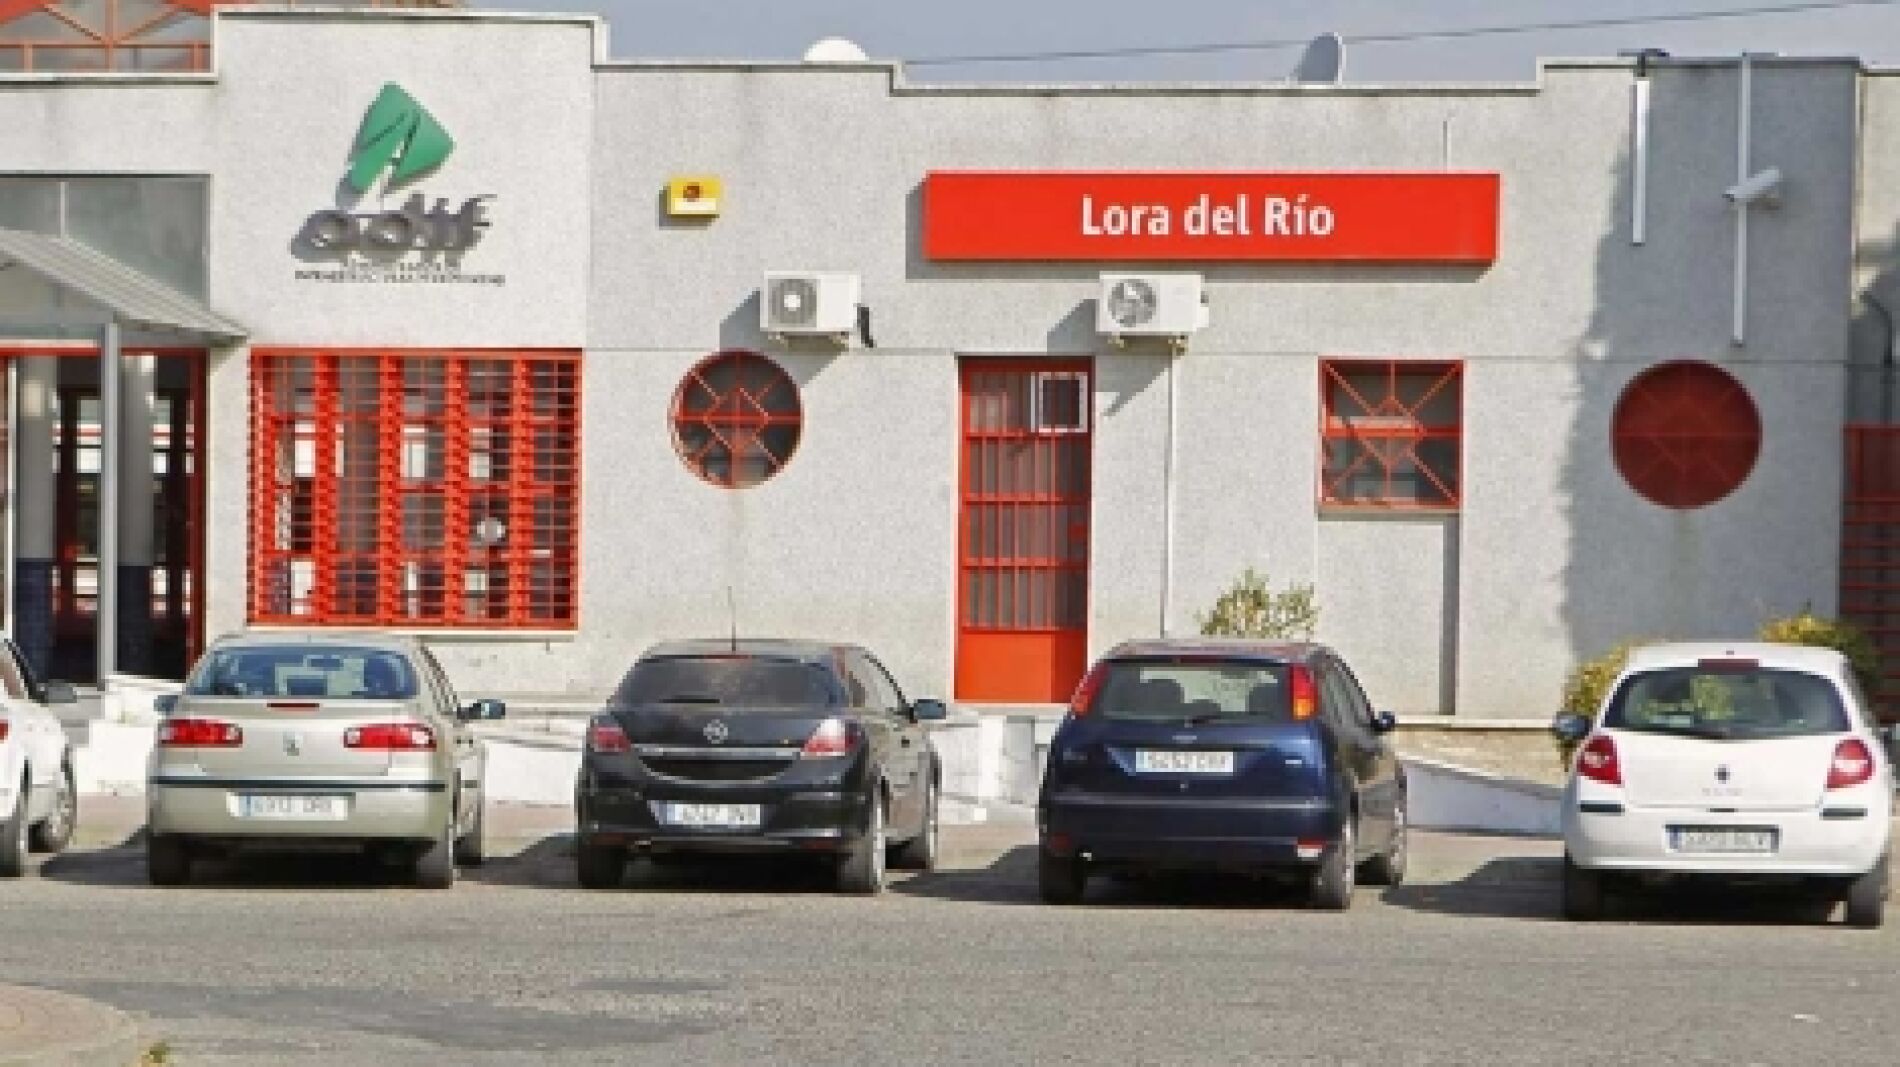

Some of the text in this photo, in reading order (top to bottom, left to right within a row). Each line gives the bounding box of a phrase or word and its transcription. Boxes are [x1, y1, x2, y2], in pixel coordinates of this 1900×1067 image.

[1082, 193, 1334, 235] Lora del Río
